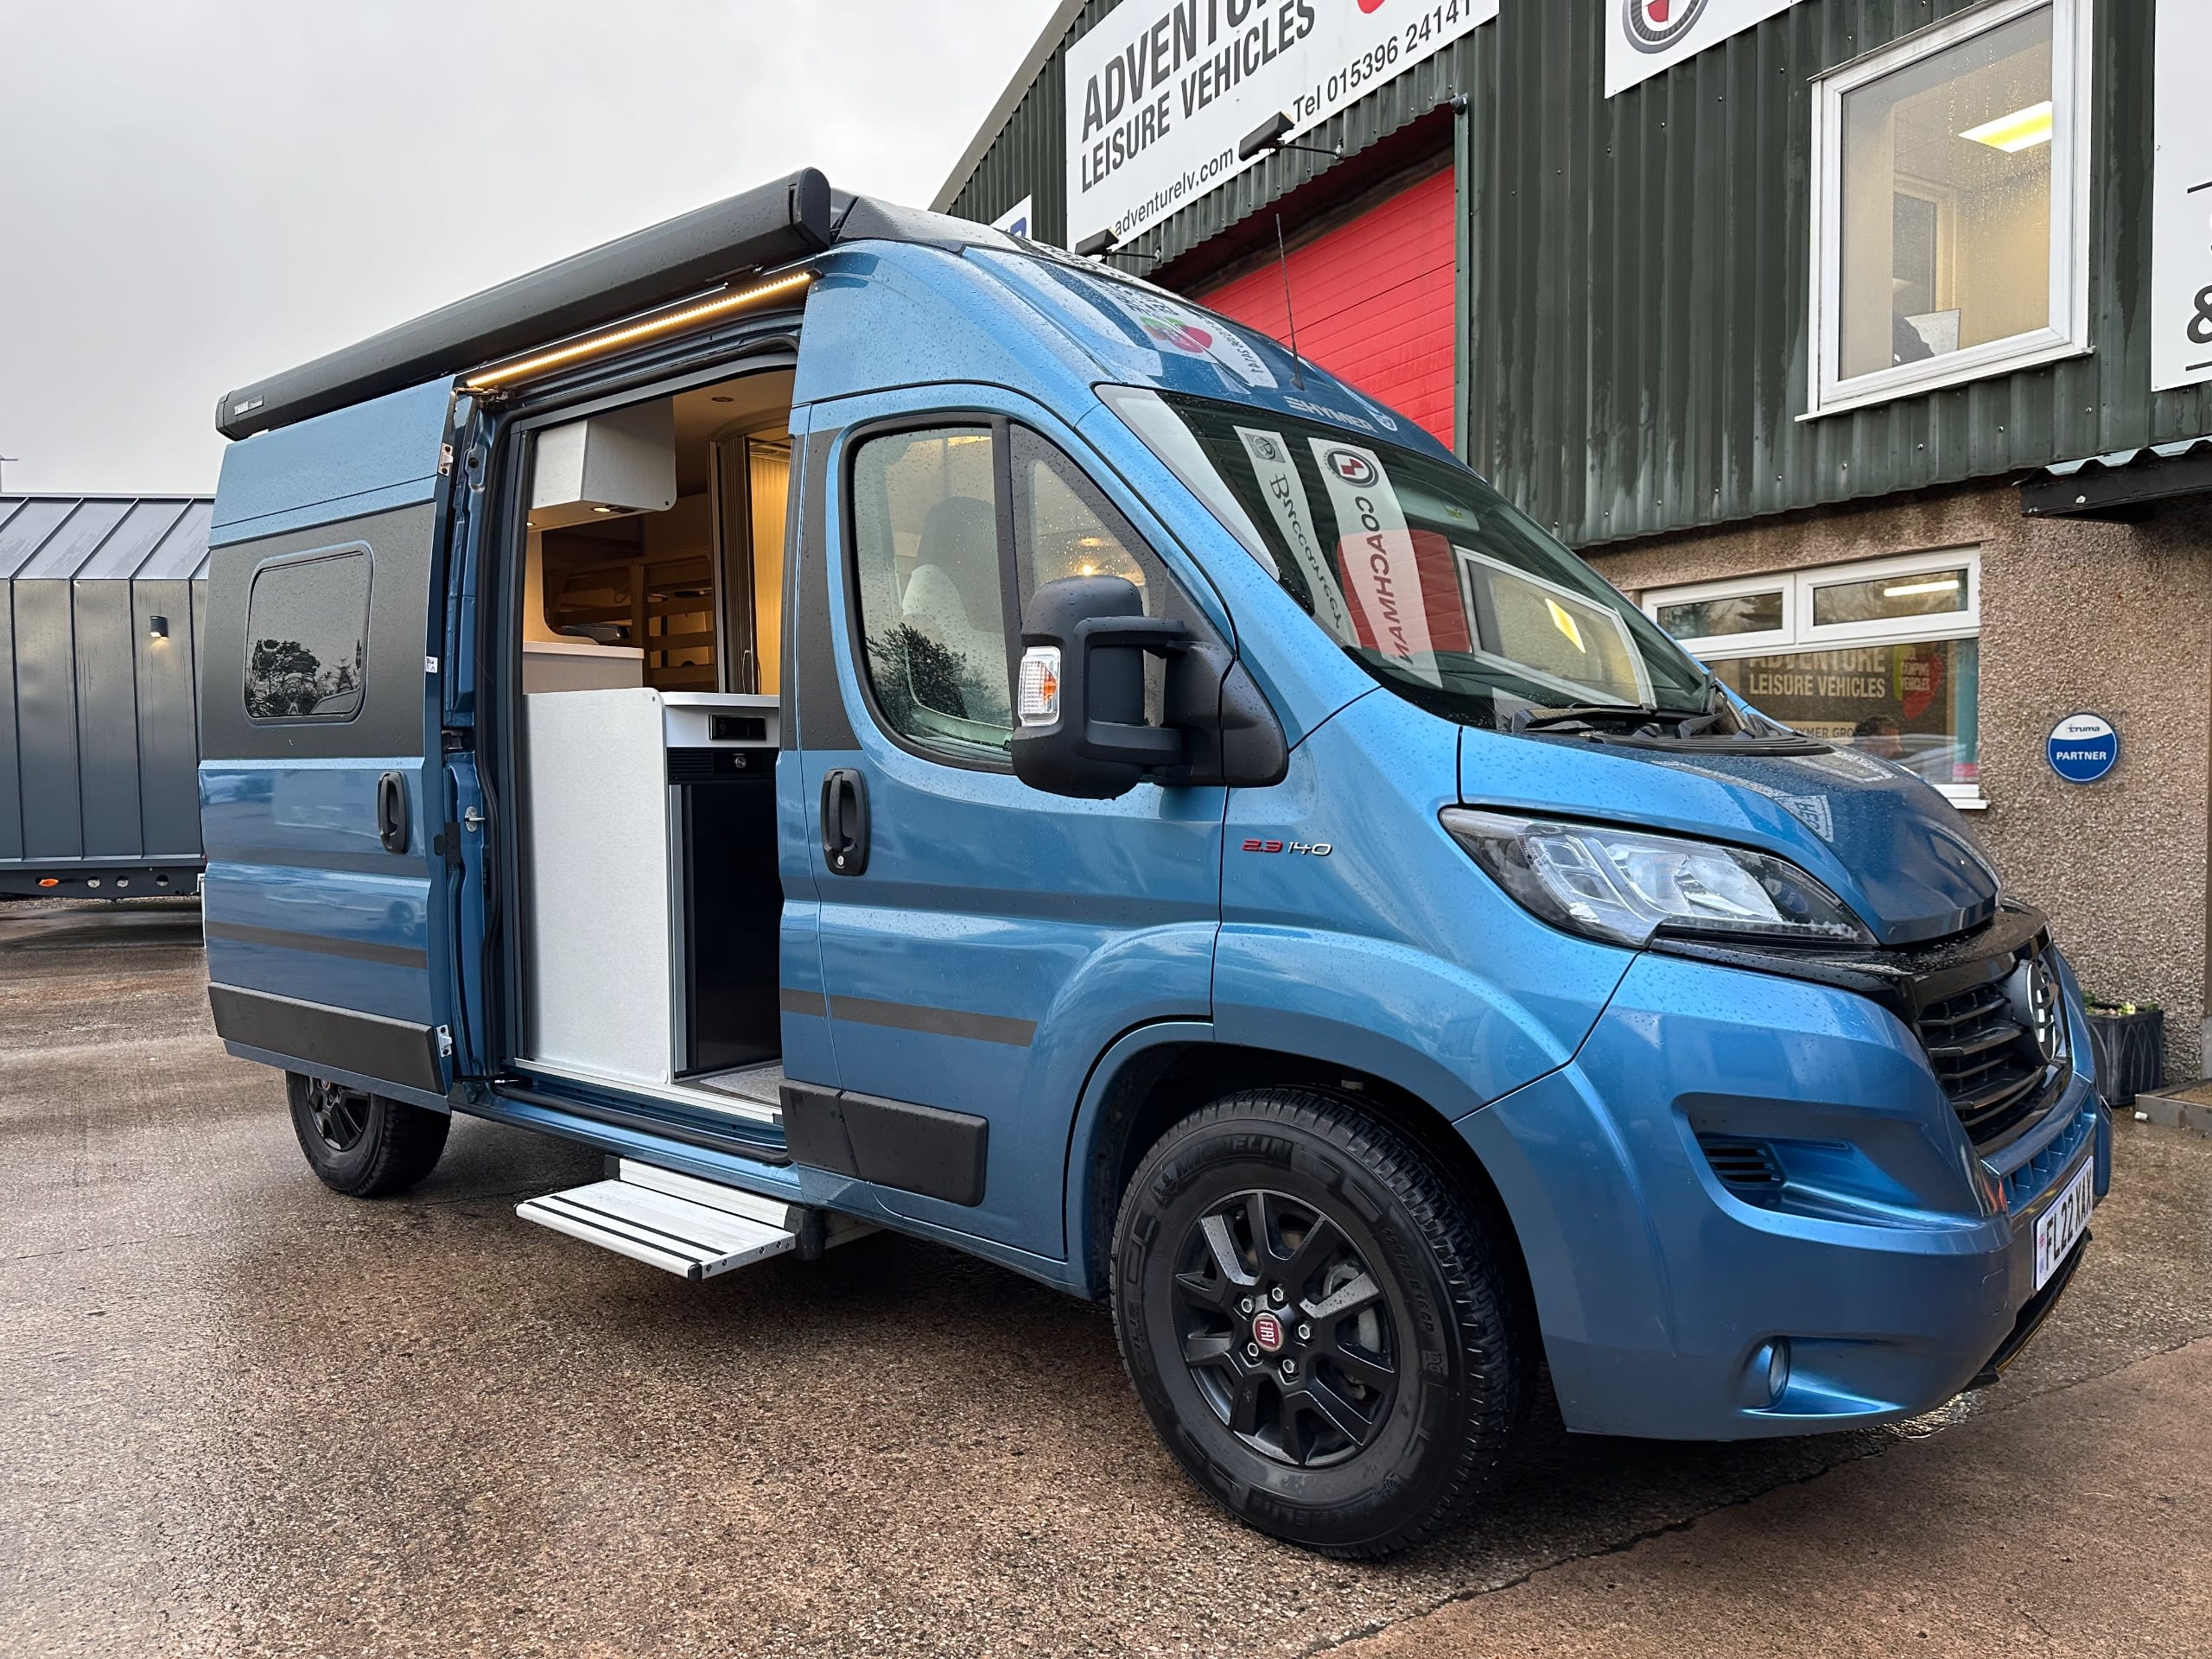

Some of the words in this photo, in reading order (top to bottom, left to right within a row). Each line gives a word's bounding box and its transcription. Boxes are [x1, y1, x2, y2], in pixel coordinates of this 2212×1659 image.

[1082, 0, 1266, 143] ADVENT
[1082, 90, 1170, 194] LEISURE
[1180, 0, 1315, 119] VEHICLES
[1115, 148, 1233, 237] adventurelv.com
[1293, 85, 1321, 123] Tel
[1327, 35, 1398, 102] 015396
[1405, 0, 1471, 54] 24141
[1750, 673, 1814, 696] LEISURE
[1817, 677, 1885, 698] VEHICLES
[2067, 723, 2101, 733] truma
[2056, 751, 2107, 760] PARTNER
[1241, 839, 1283, 854] 2.3
[1287, 842, 1332, 856] 140
[2046, 1193, 2073, 1271] FL22
[2075, 1167, 2092, 1231] XAX
[1260, 1320, 1275, 1344] FIAT
